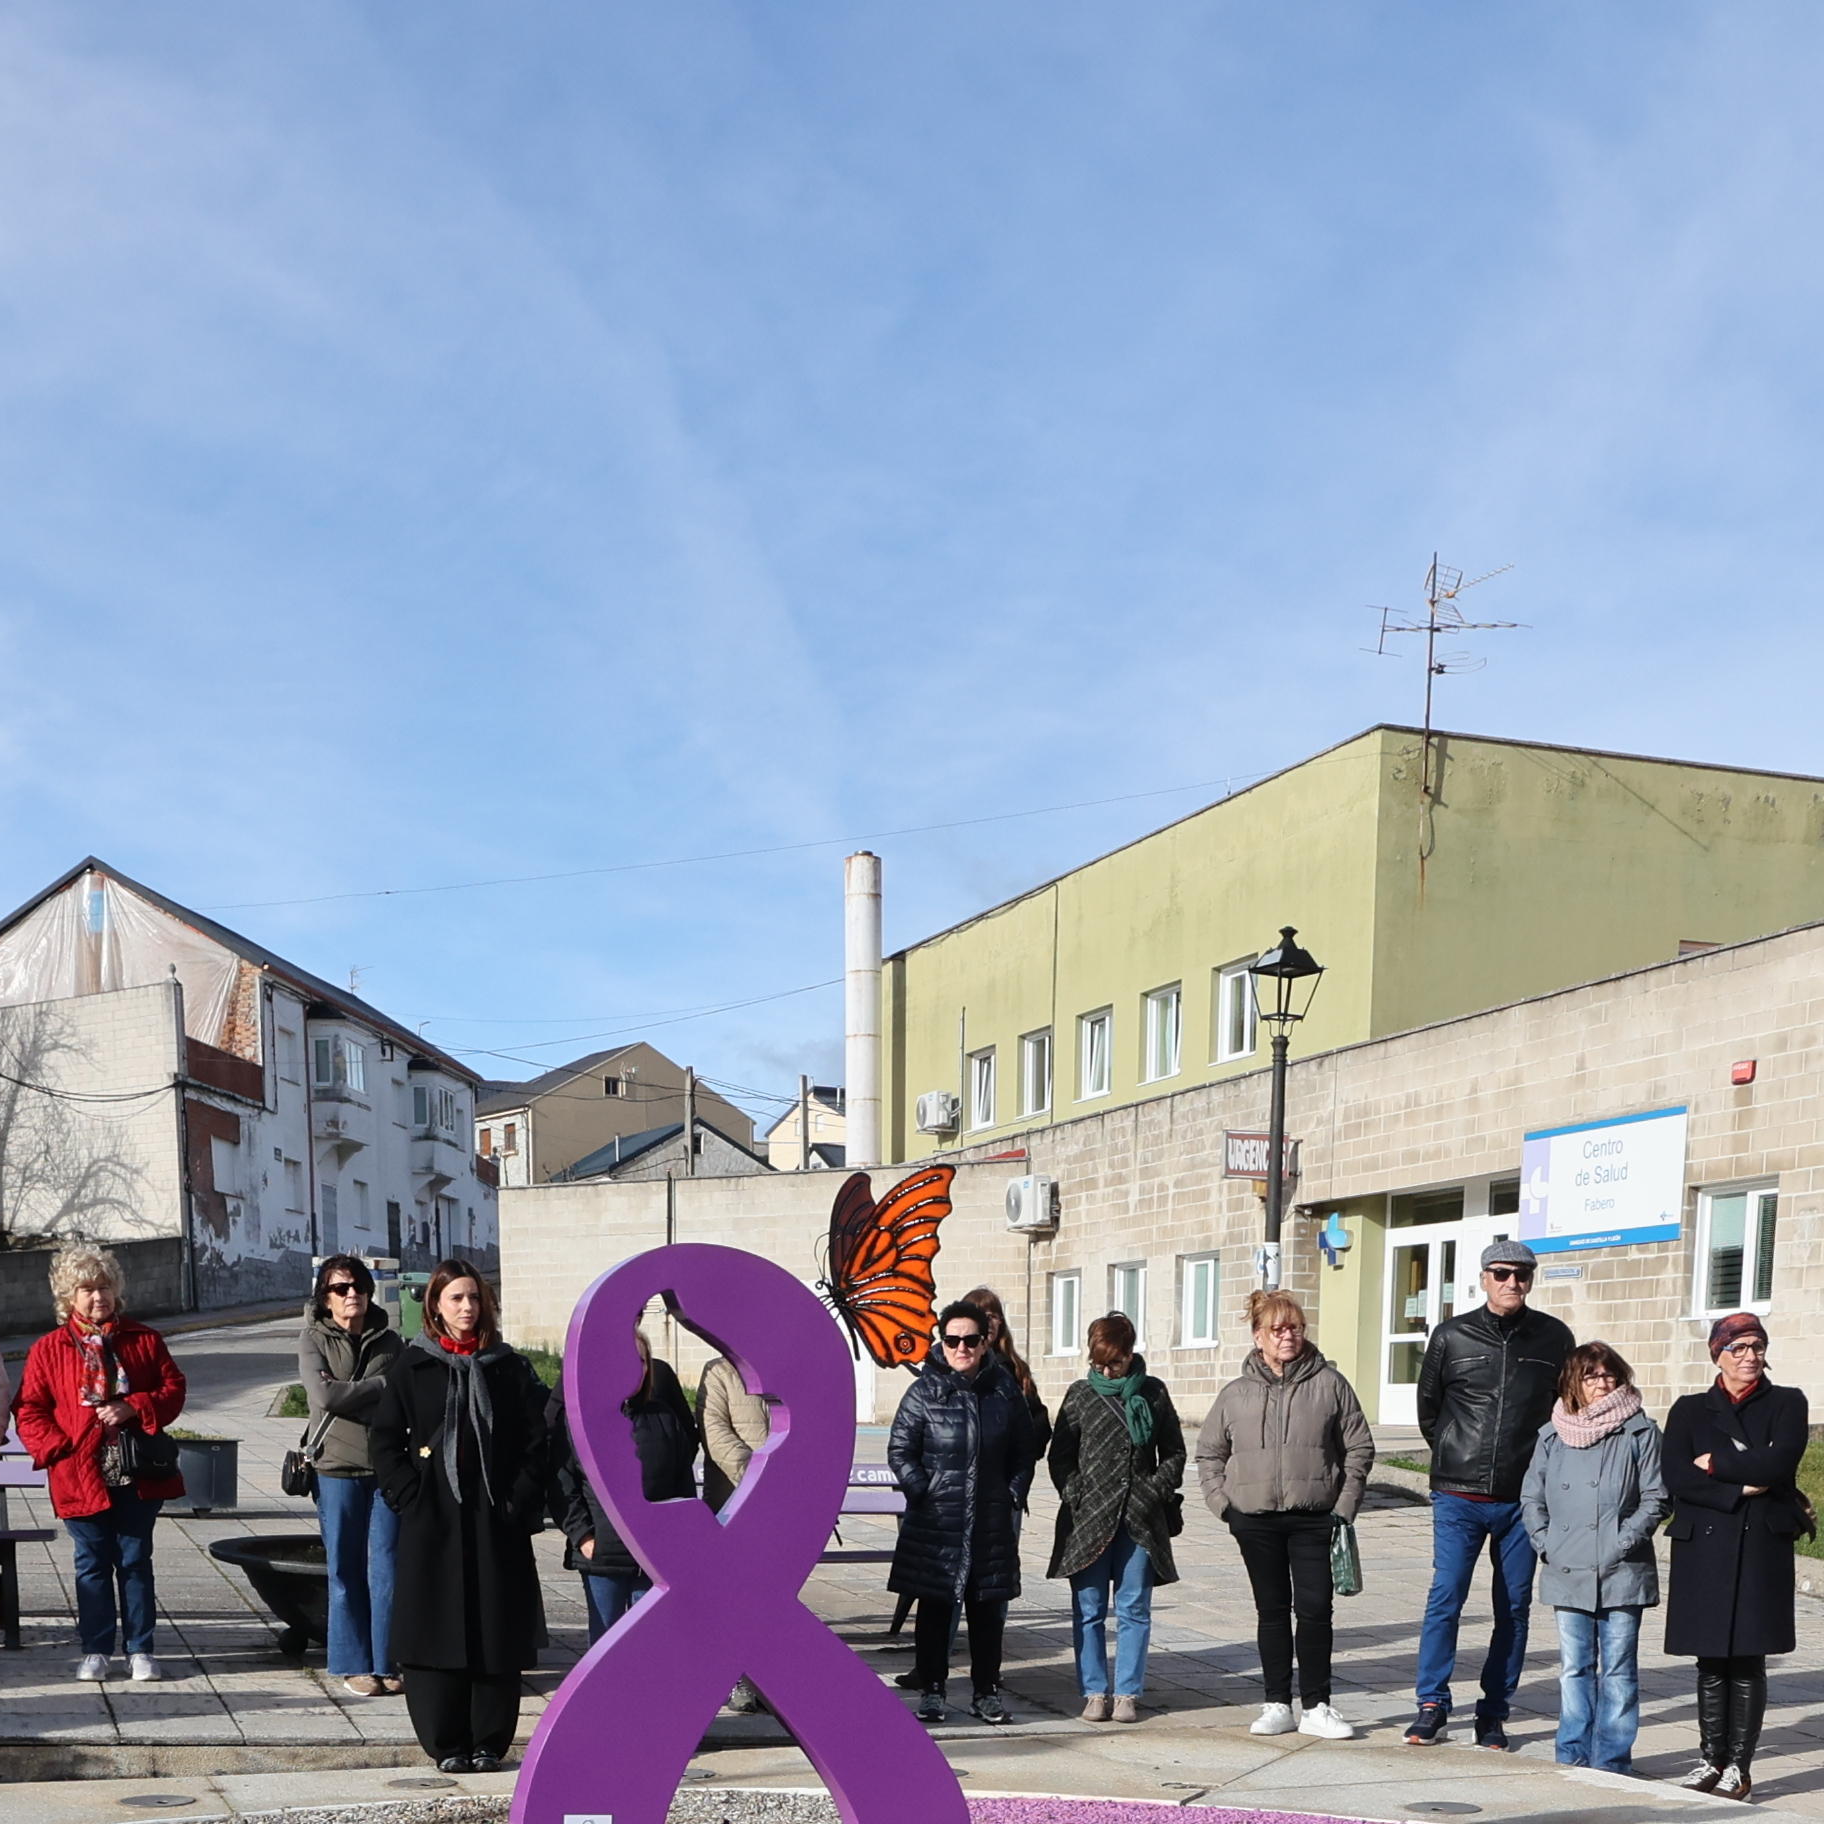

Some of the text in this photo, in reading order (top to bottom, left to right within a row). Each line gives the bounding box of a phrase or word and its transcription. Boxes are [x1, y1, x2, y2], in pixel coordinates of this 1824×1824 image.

[1228, 1138, 1286, 1171] URGENC
[1583, 1139, 1623, 1159] Centro
[1575, 1160, 1629, 1187] de Salud
[1584, 1198, 1615, 1212] Fabero
